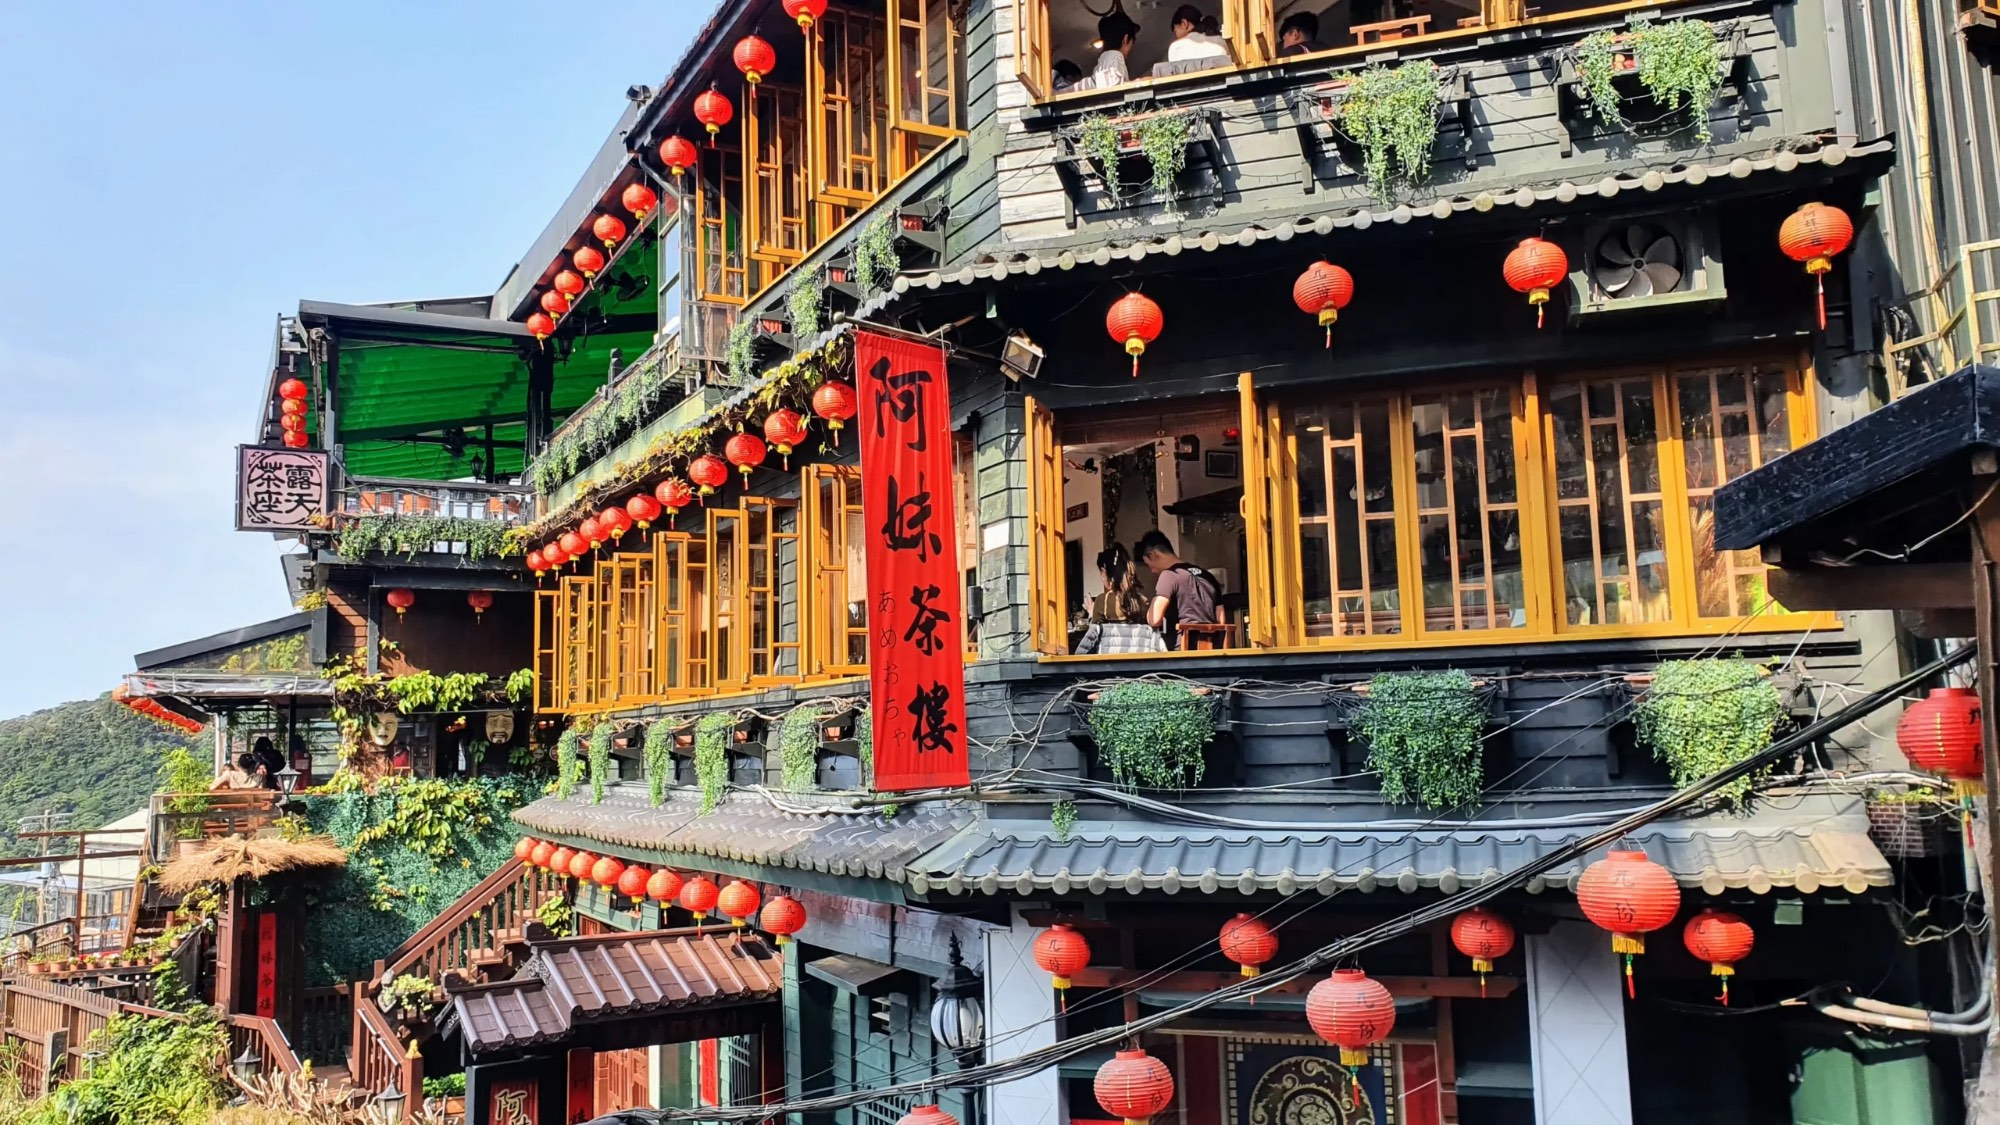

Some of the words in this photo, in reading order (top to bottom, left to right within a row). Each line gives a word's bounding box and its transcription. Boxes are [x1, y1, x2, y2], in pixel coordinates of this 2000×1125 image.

[869, 356, 958, 754] 阿妹茶樓
[877, 588, 907, 748] あめおちゃ
[1613, 869, 1636, 924] 九份
[1048, 938, 1061, 971] 九份
[1478, 919, 1494, 956] 九份
[1356, 992, 1377, 1040] 九份
